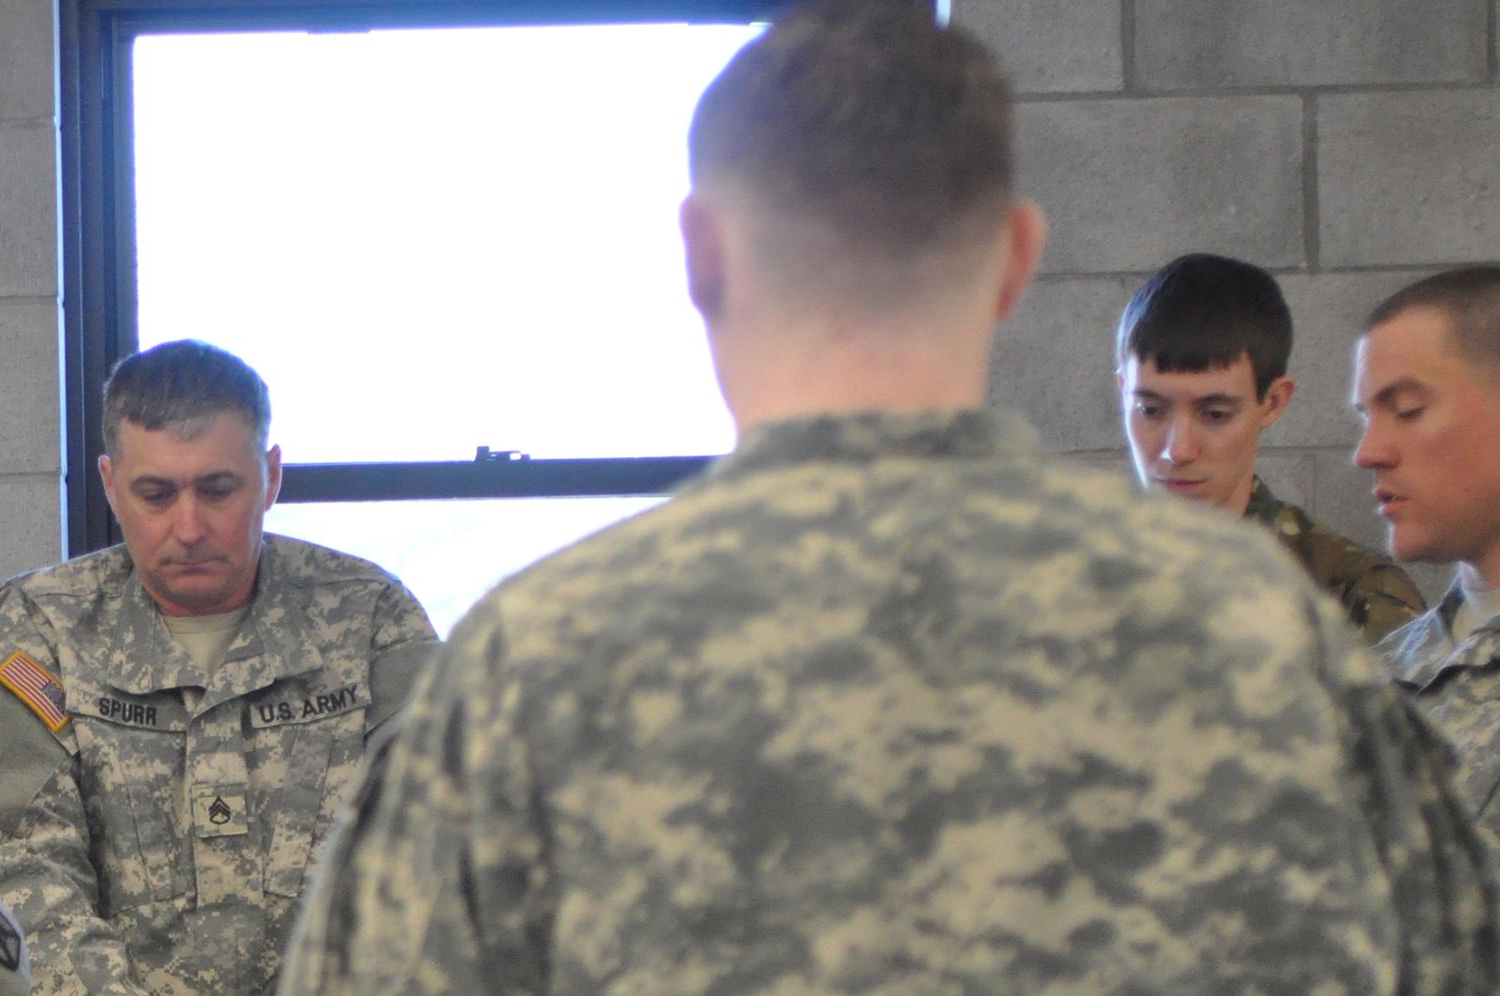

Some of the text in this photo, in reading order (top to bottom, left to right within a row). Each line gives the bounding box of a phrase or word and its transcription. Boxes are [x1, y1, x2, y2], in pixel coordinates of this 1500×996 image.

[99, 697, 157, 727] SPURR
[259, 685, 359, 724] U.S. ARMY
